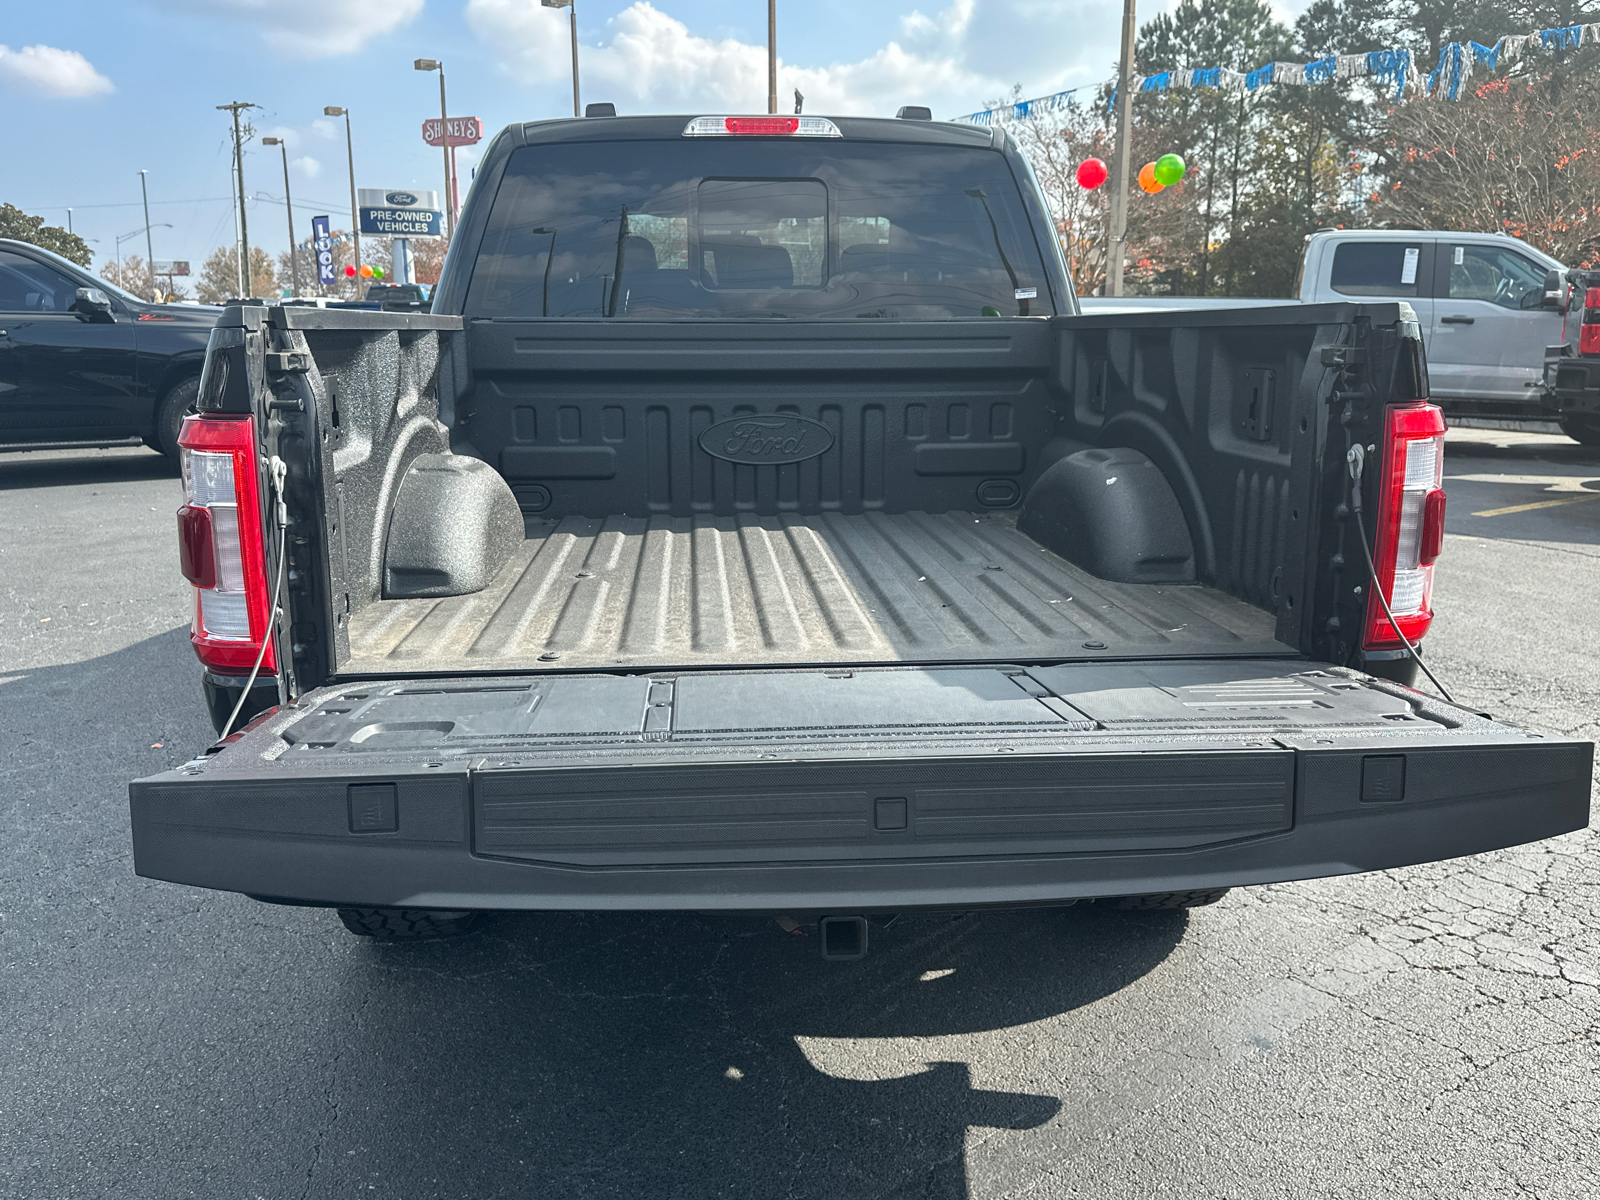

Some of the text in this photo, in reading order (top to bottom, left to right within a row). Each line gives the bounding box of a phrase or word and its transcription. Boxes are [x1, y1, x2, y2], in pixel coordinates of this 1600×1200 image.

[370, 210, 433, 222] PRE-OWNED
[377, 221, 429, 233] VEHICLES
[317, 224, 335, 279] LOOK
[724, 421, 807, 455] Ford
